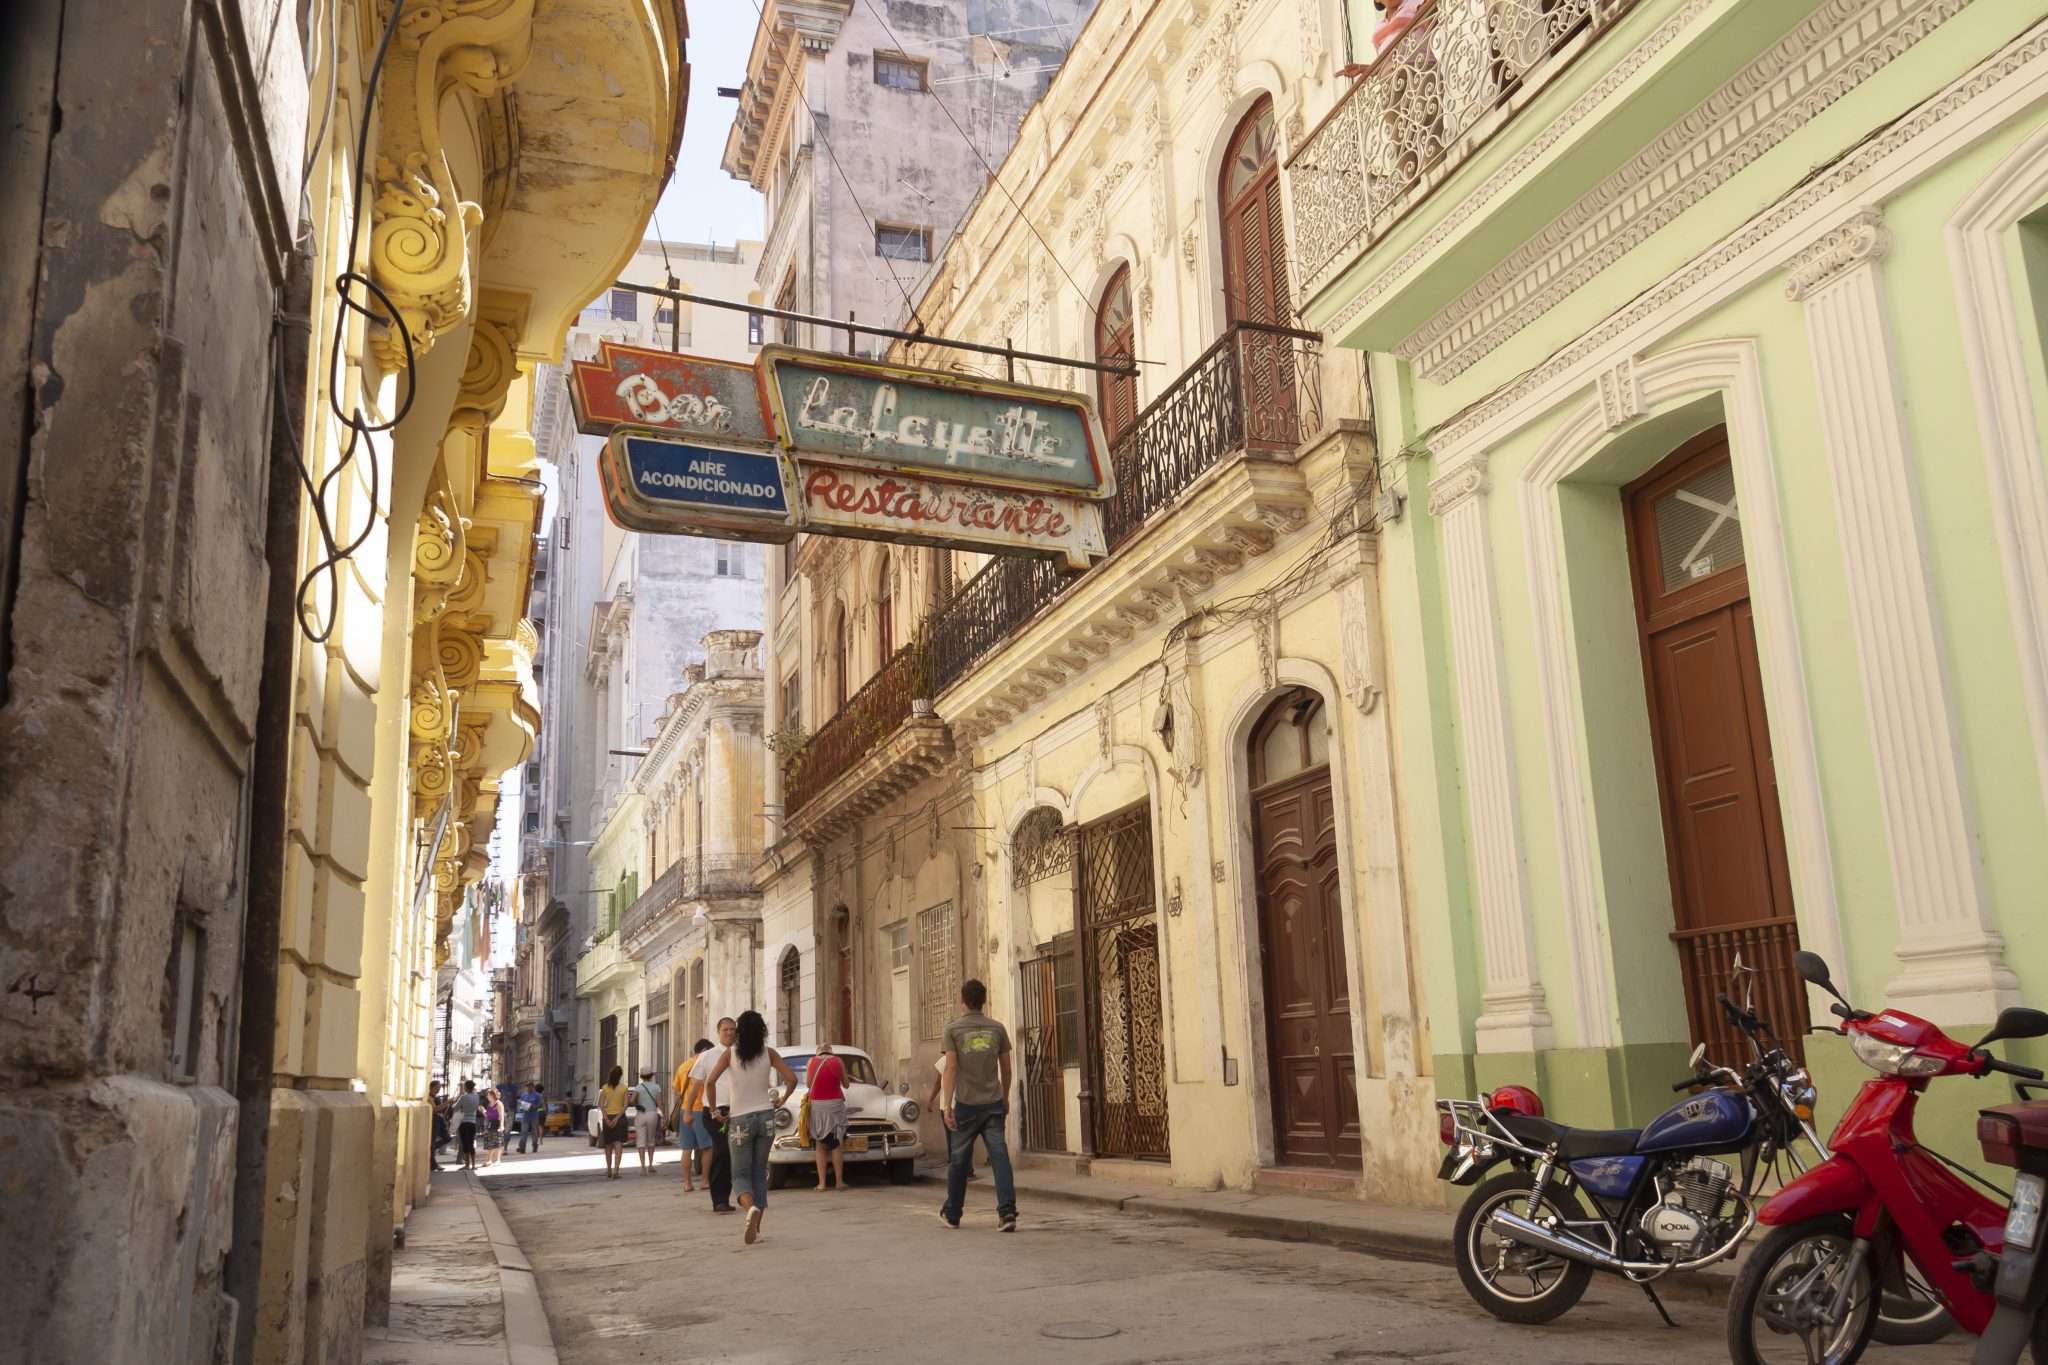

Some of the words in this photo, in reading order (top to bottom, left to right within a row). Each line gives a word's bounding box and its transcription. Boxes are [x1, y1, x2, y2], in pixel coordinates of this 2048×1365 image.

[616, 373, 732, 433] Bar
[688, 460, 726, 476] AIRE
[640, 470, 776, 498] ACONDICIONADO
[805, 470, 1072, 537] Restaurante
[1660, 1222, 1691, 1232] MONDIAL
